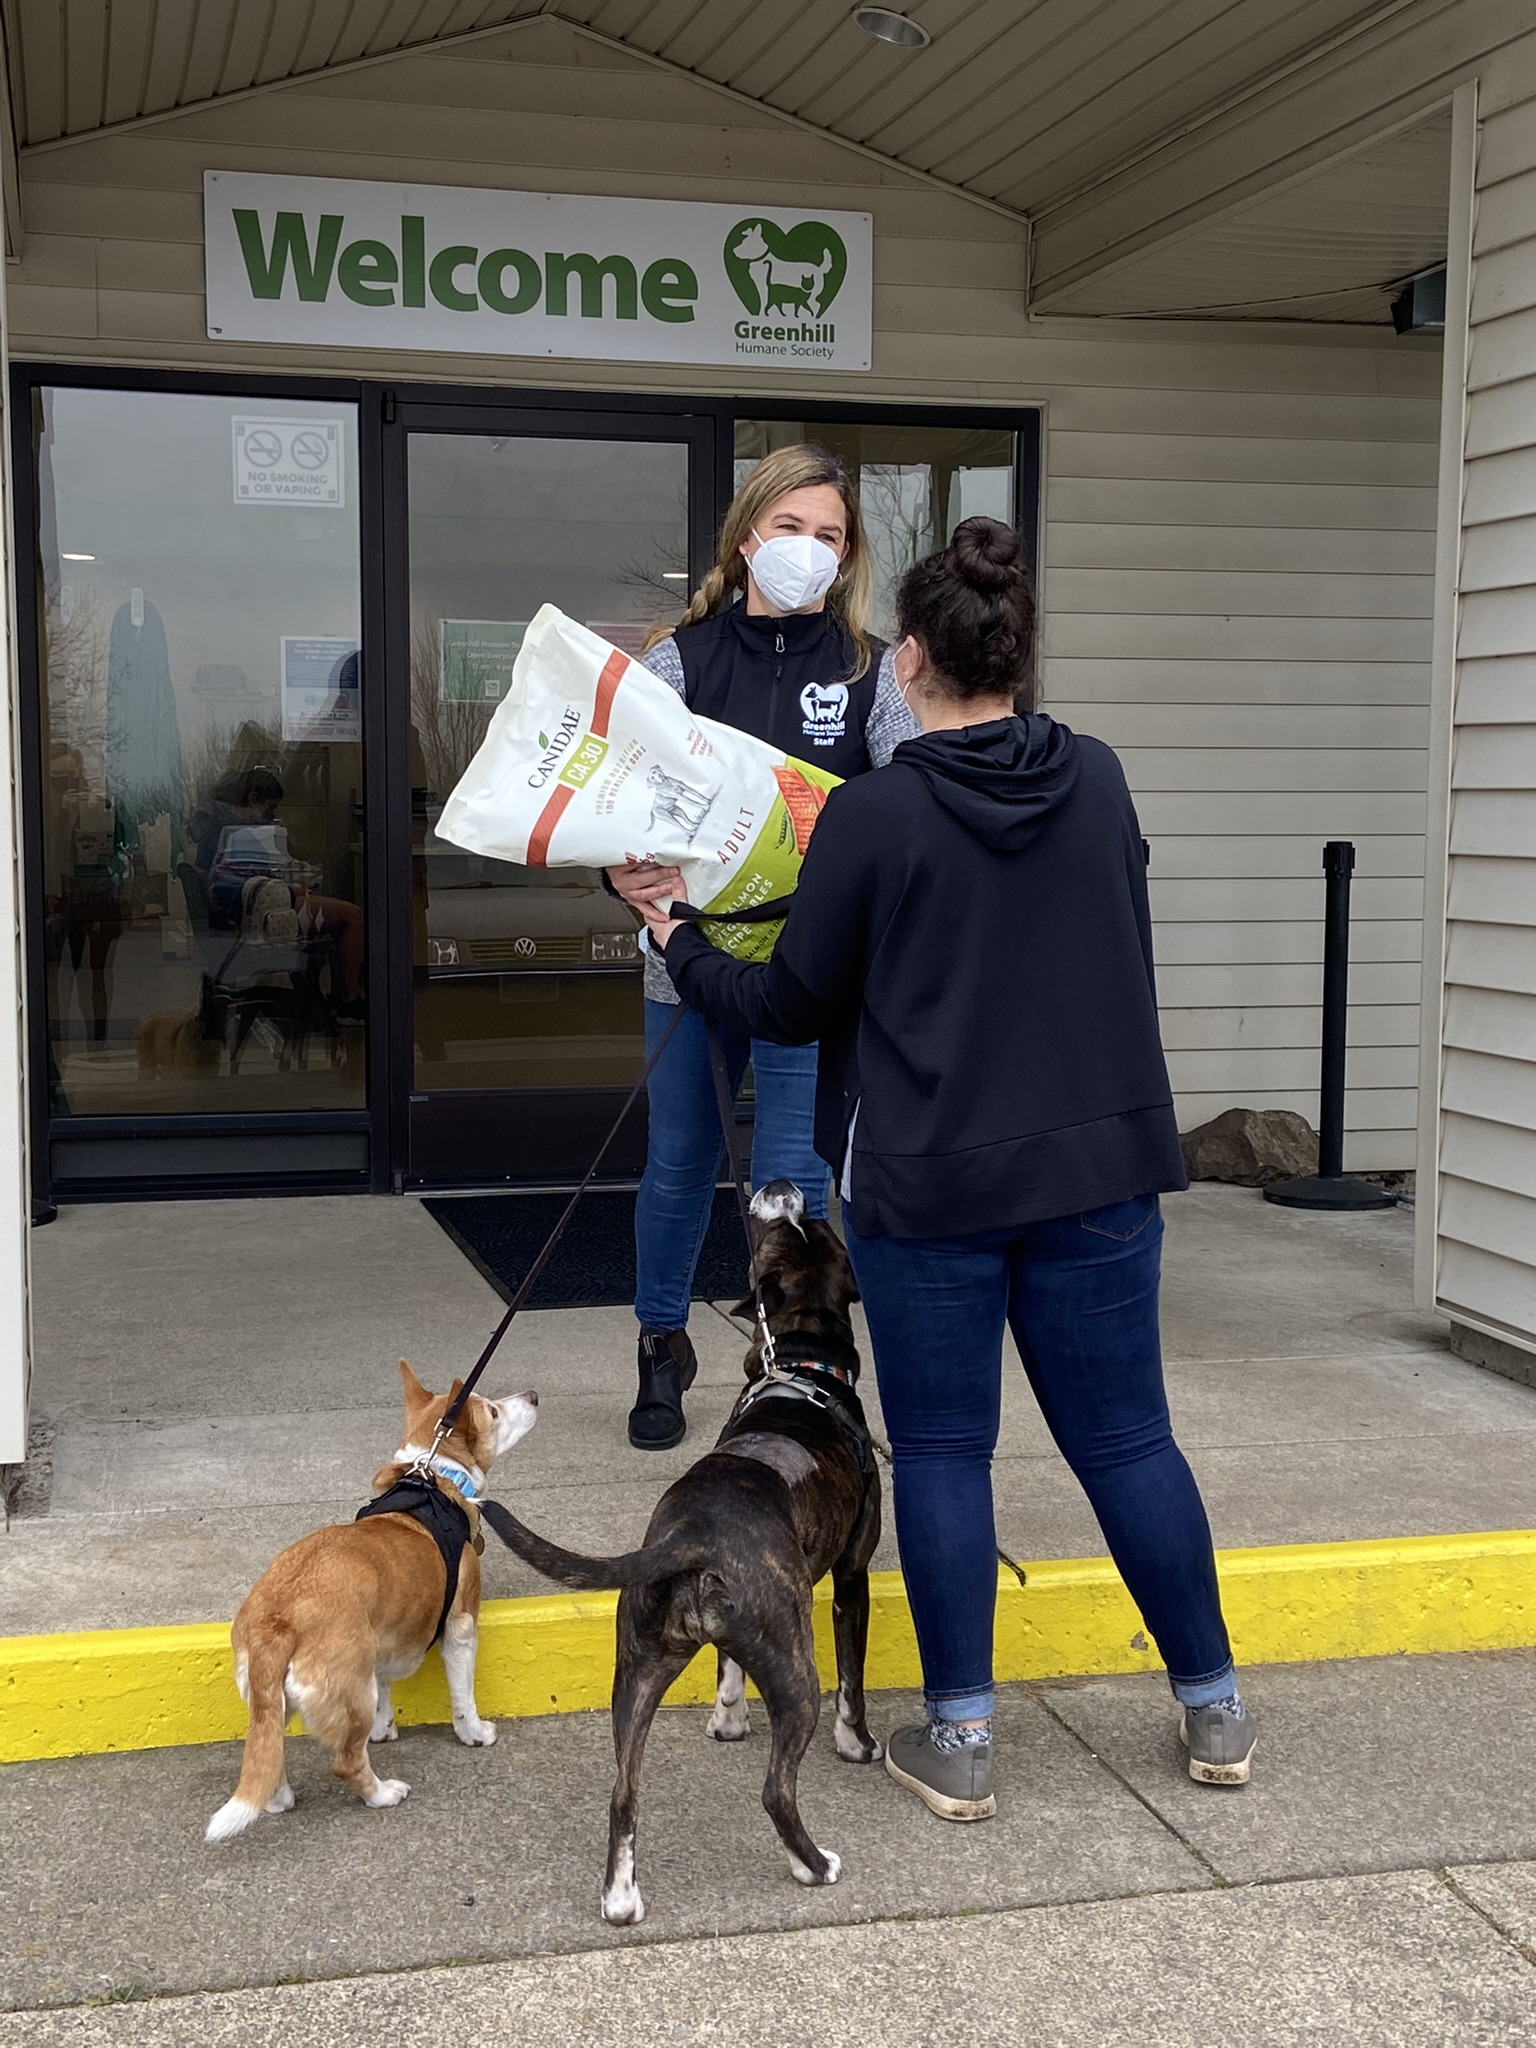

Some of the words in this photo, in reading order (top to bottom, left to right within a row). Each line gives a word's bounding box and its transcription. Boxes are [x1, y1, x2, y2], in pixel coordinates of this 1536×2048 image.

[232, 208, 698, 323] Welcome
[734, 320, 835, 343] Greenhill
[735, 342, 787, 355] Humane
[791, 344, 834, 360] Society
[247, 472, 267, 482] NO
[269, 473, 327, 484] SMOKING
[254, 484, 272, 494] OR
[275, 485, 321, 496] VAPING
[466, 651, 486, 660] Open
[802, 720, 845, 730] Greenhill
[528, 708, 581, 788] CANIDAE
[813, 737, 835, 746] Staff
[717, 806, 754, 865] ADULT
[702, 920, 723, 936] EAL
[727, 873, 762, 913] ALMON
[721, 925, 752, 953] ECIPE
